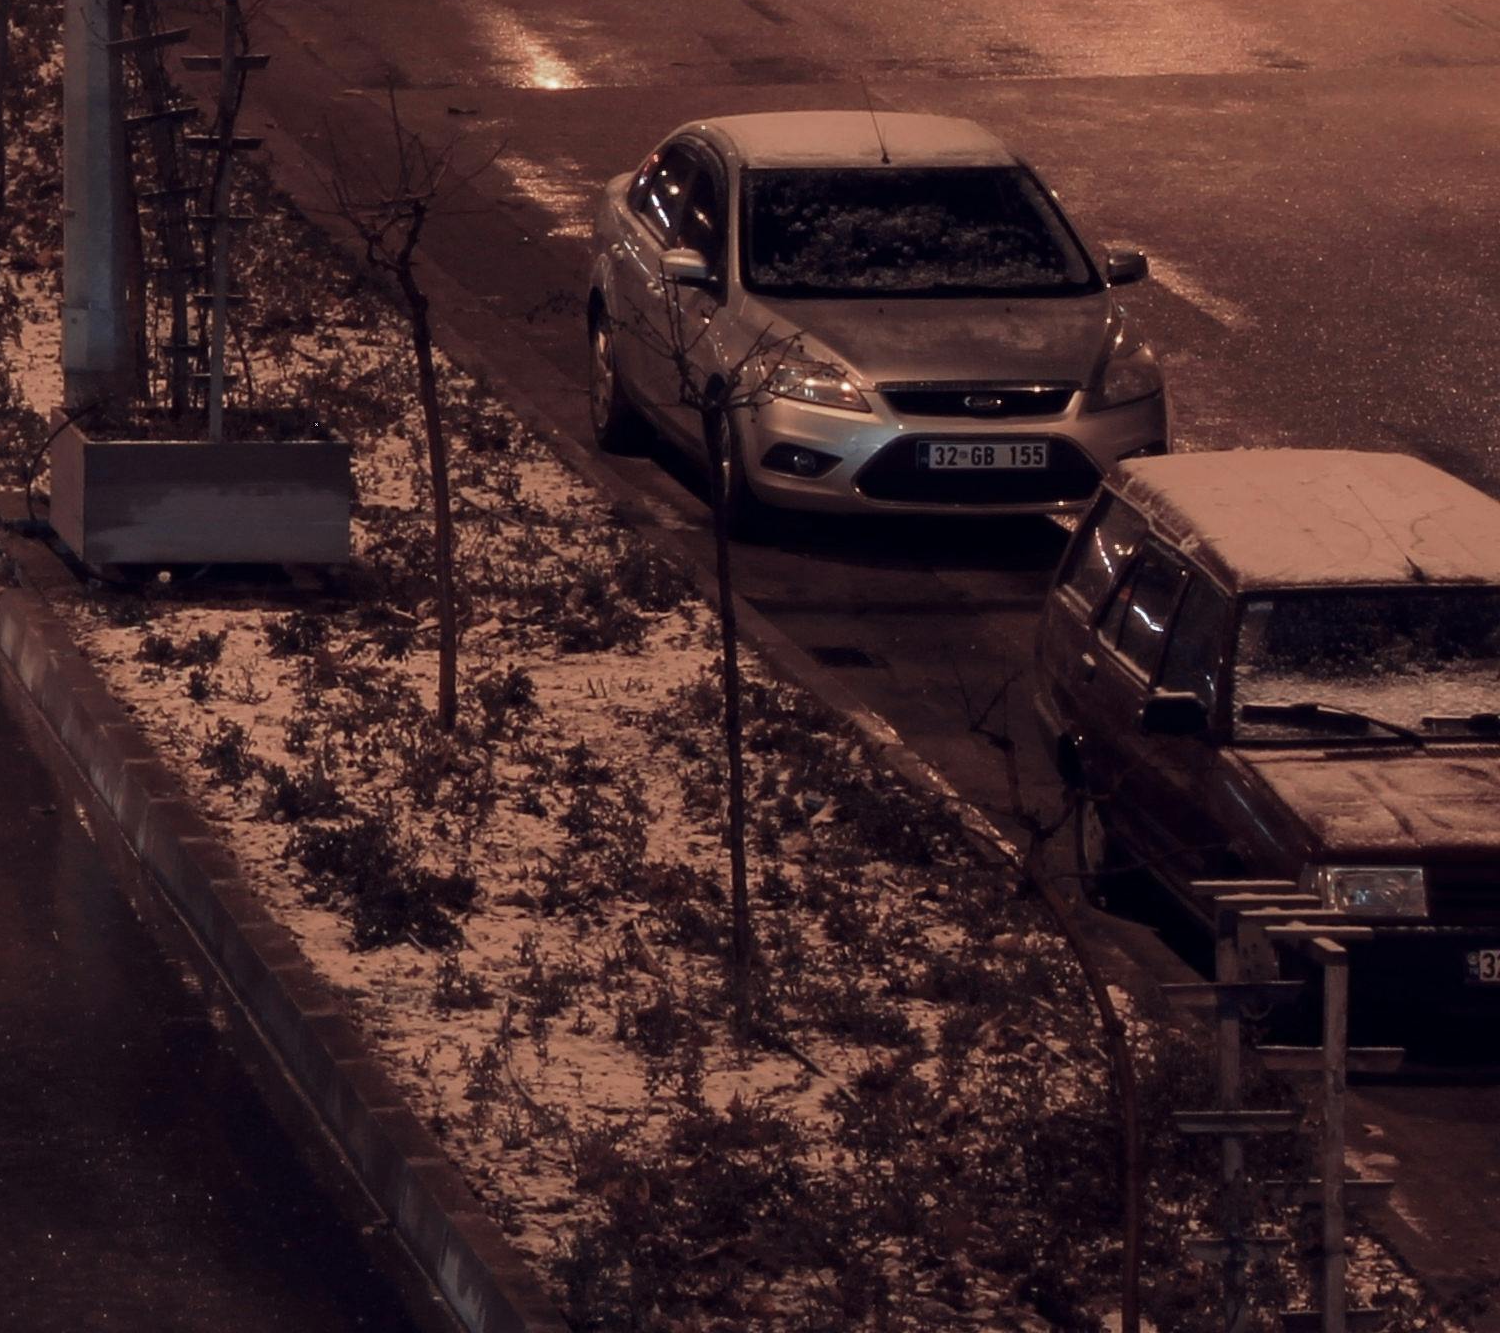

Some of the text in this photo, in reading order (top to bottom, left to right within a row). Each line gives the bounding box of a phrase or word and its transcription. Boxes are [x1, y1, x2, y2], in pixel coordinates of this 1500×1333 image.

[934, 445, 1044, 467] 32 GB 155
